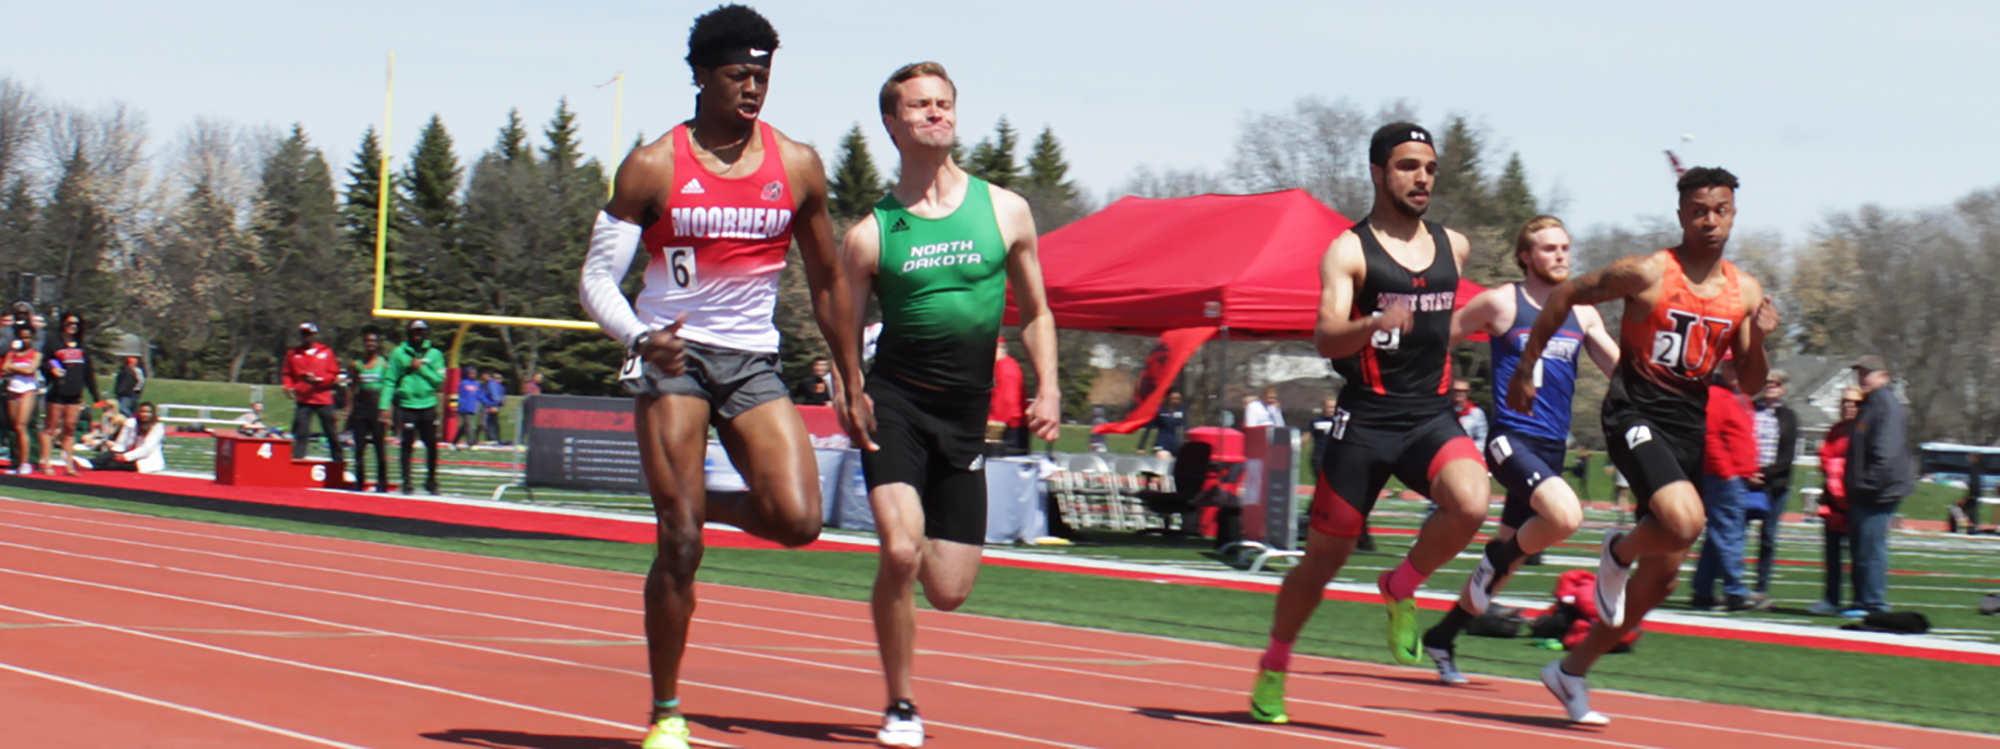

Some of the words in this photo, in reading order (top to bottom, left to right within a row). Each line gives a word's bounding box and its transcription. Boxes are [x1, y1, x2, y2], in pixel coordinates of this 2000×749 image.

[671, 206, 792, 238] MOORHEAD
[910, 240, 973, 257] NORTH
[671, 250, 690, 288] 6
[903, 253, 982, 273] DAKOTA
[1420, 291, 1455, 312] STATE
[1657, 334, 1674, 363] 2
[1667, 309, 1732, 380] U
[257, 442, 272, 459] 4
[310, 464, 326, 481] 6
